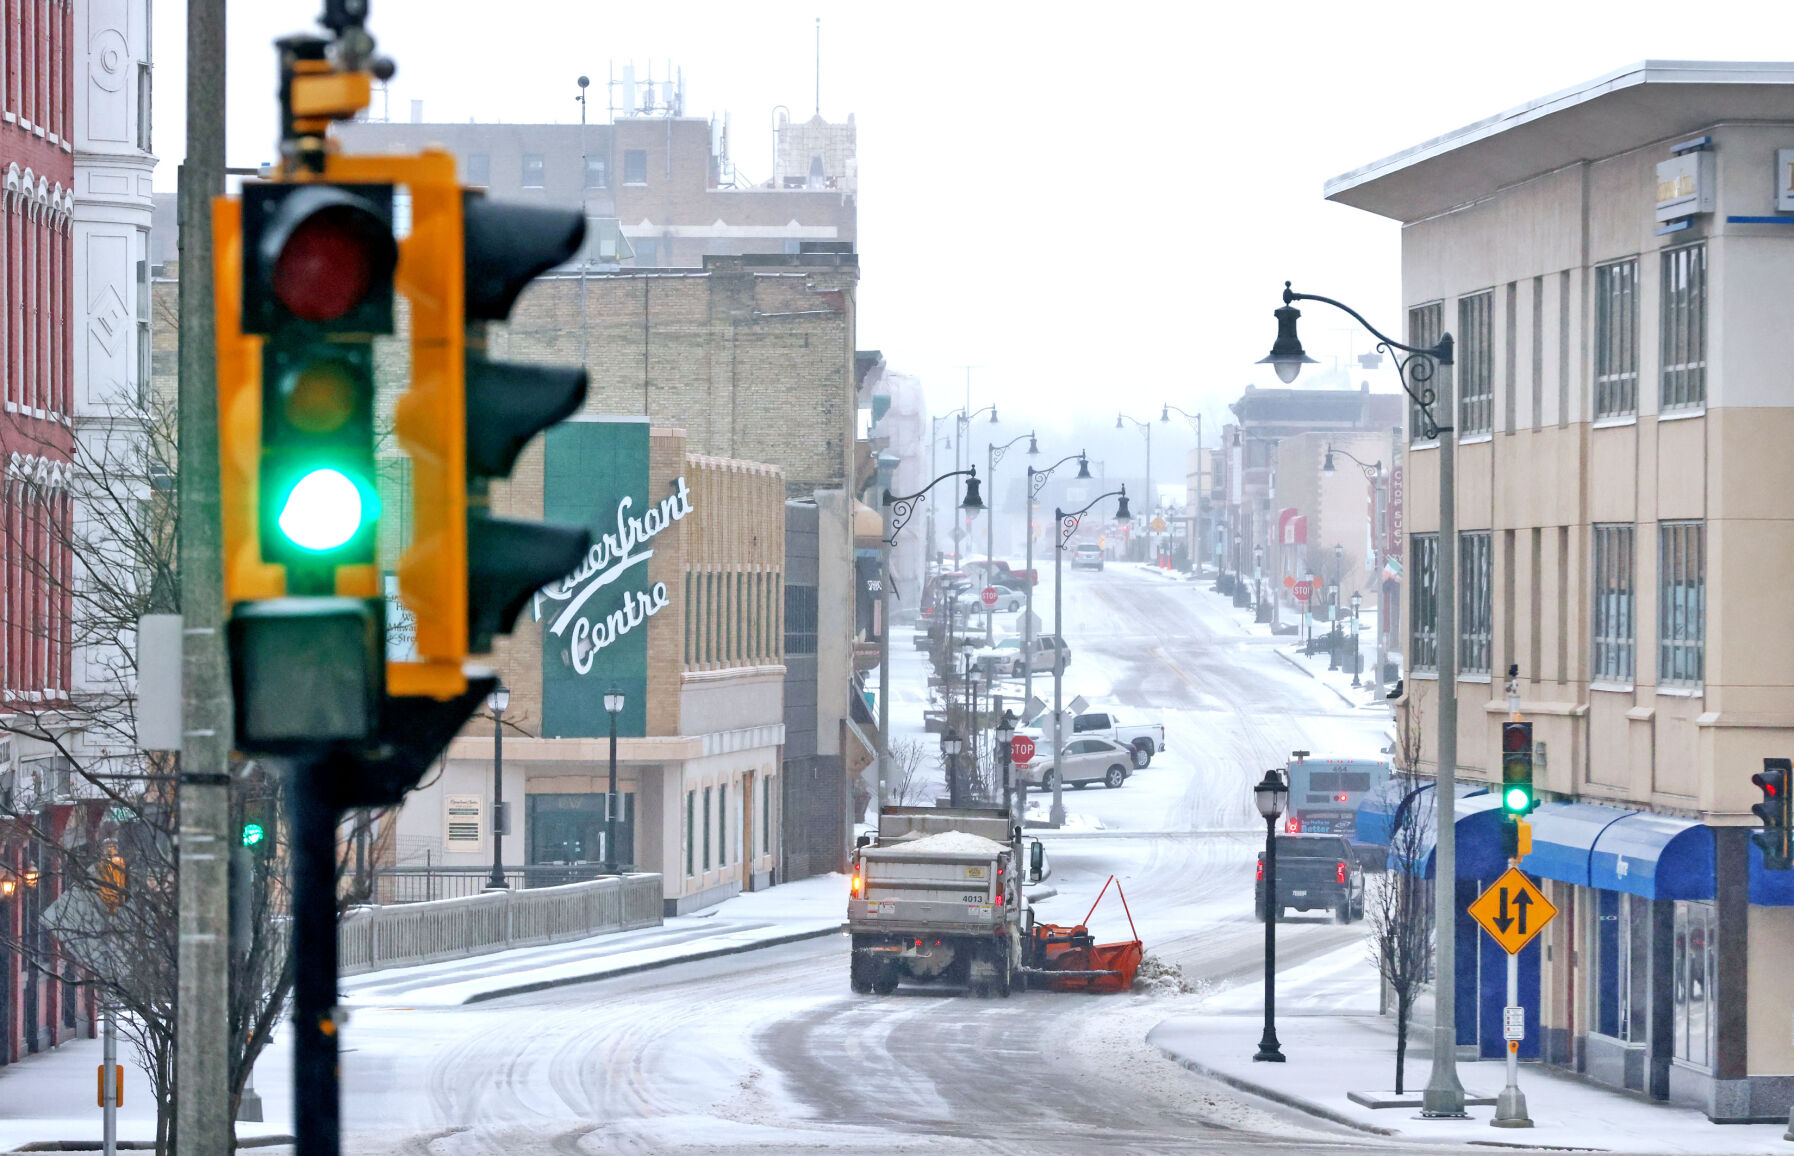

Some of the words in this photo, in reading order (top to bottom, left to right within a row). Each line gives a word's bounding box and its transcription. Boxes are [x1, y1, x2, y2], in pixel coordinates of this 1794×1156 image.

[982, 592, 997, 600] STOP
[571, 581, 670, 676] Centre
[962, 895, 983, 903] 4013
